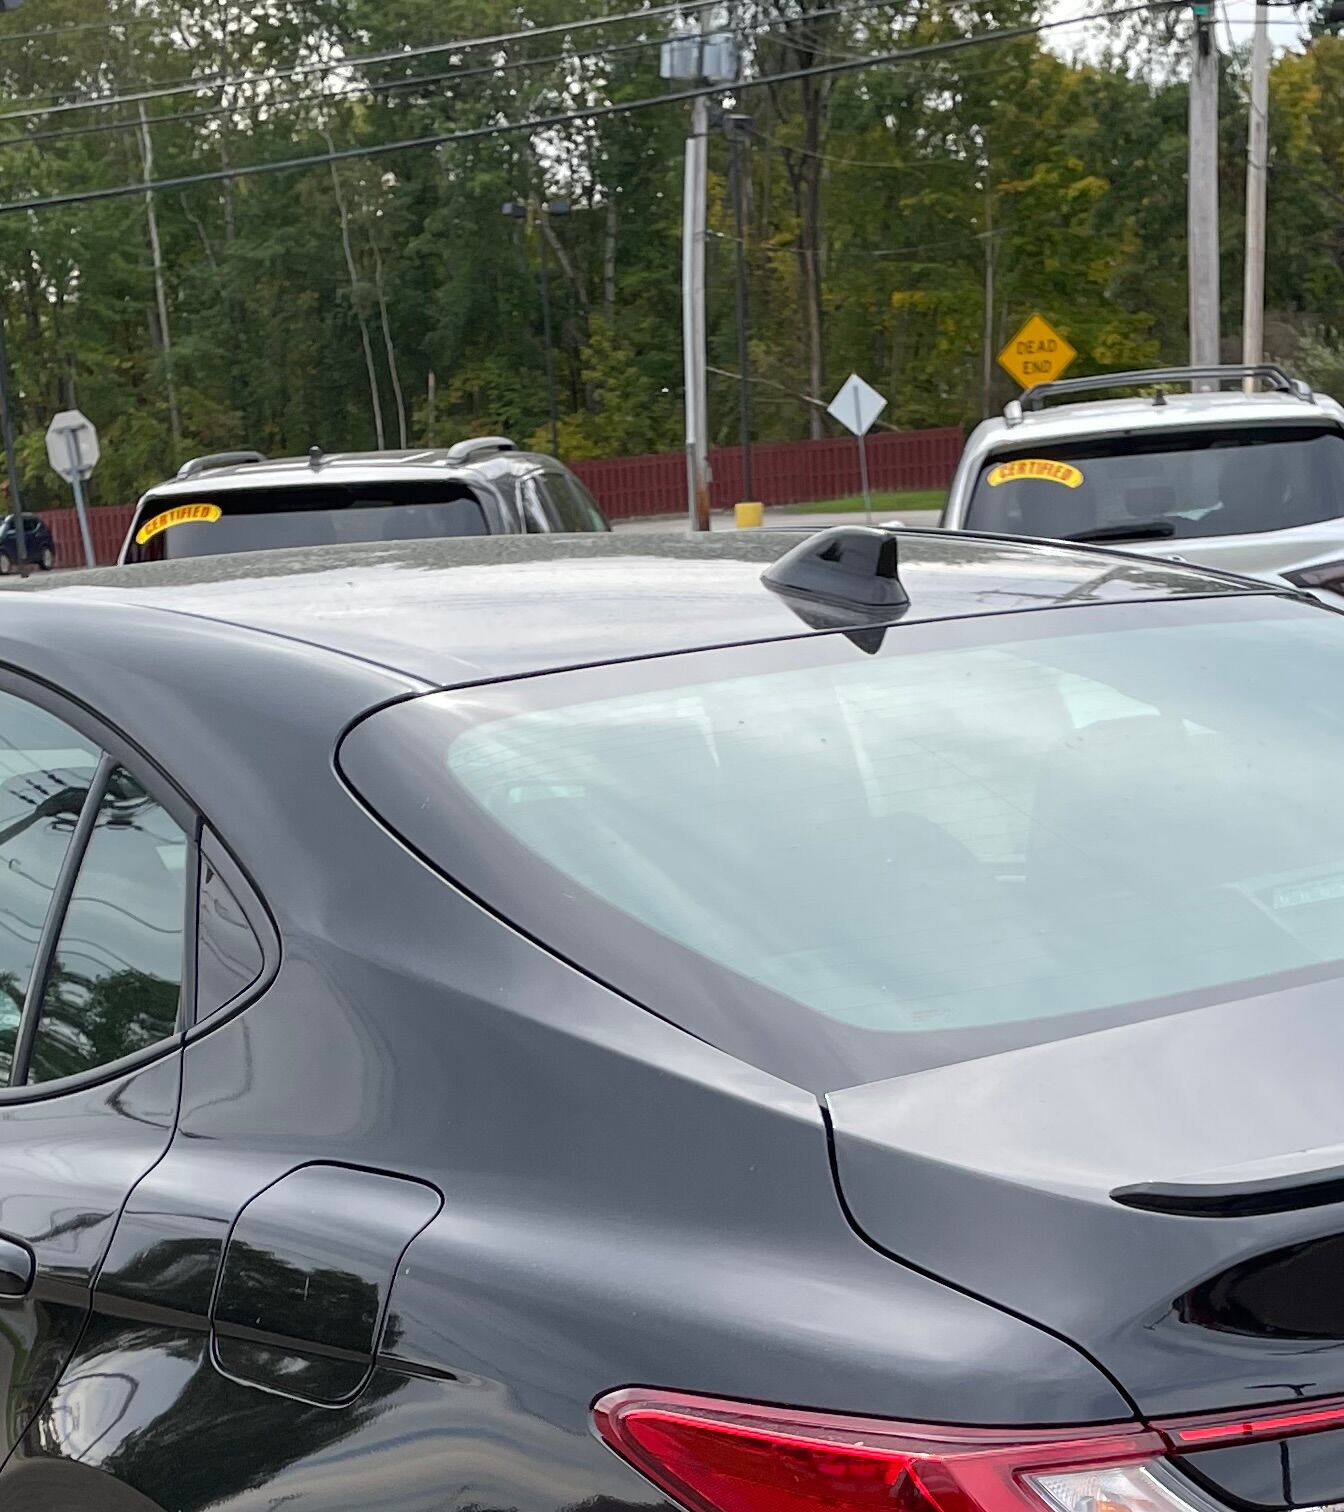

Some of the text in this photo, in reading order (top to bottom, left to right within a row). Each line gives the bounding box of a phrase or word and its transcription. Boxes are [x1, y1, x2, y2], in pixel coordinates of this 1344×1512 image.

[1016, 339, 1058, 355] DEAD
[1022, 360, 1052, 375] END
[999, 460, 1074, 482] CERTIFIED
[145, 506, 211, 536] CERTIFIED
